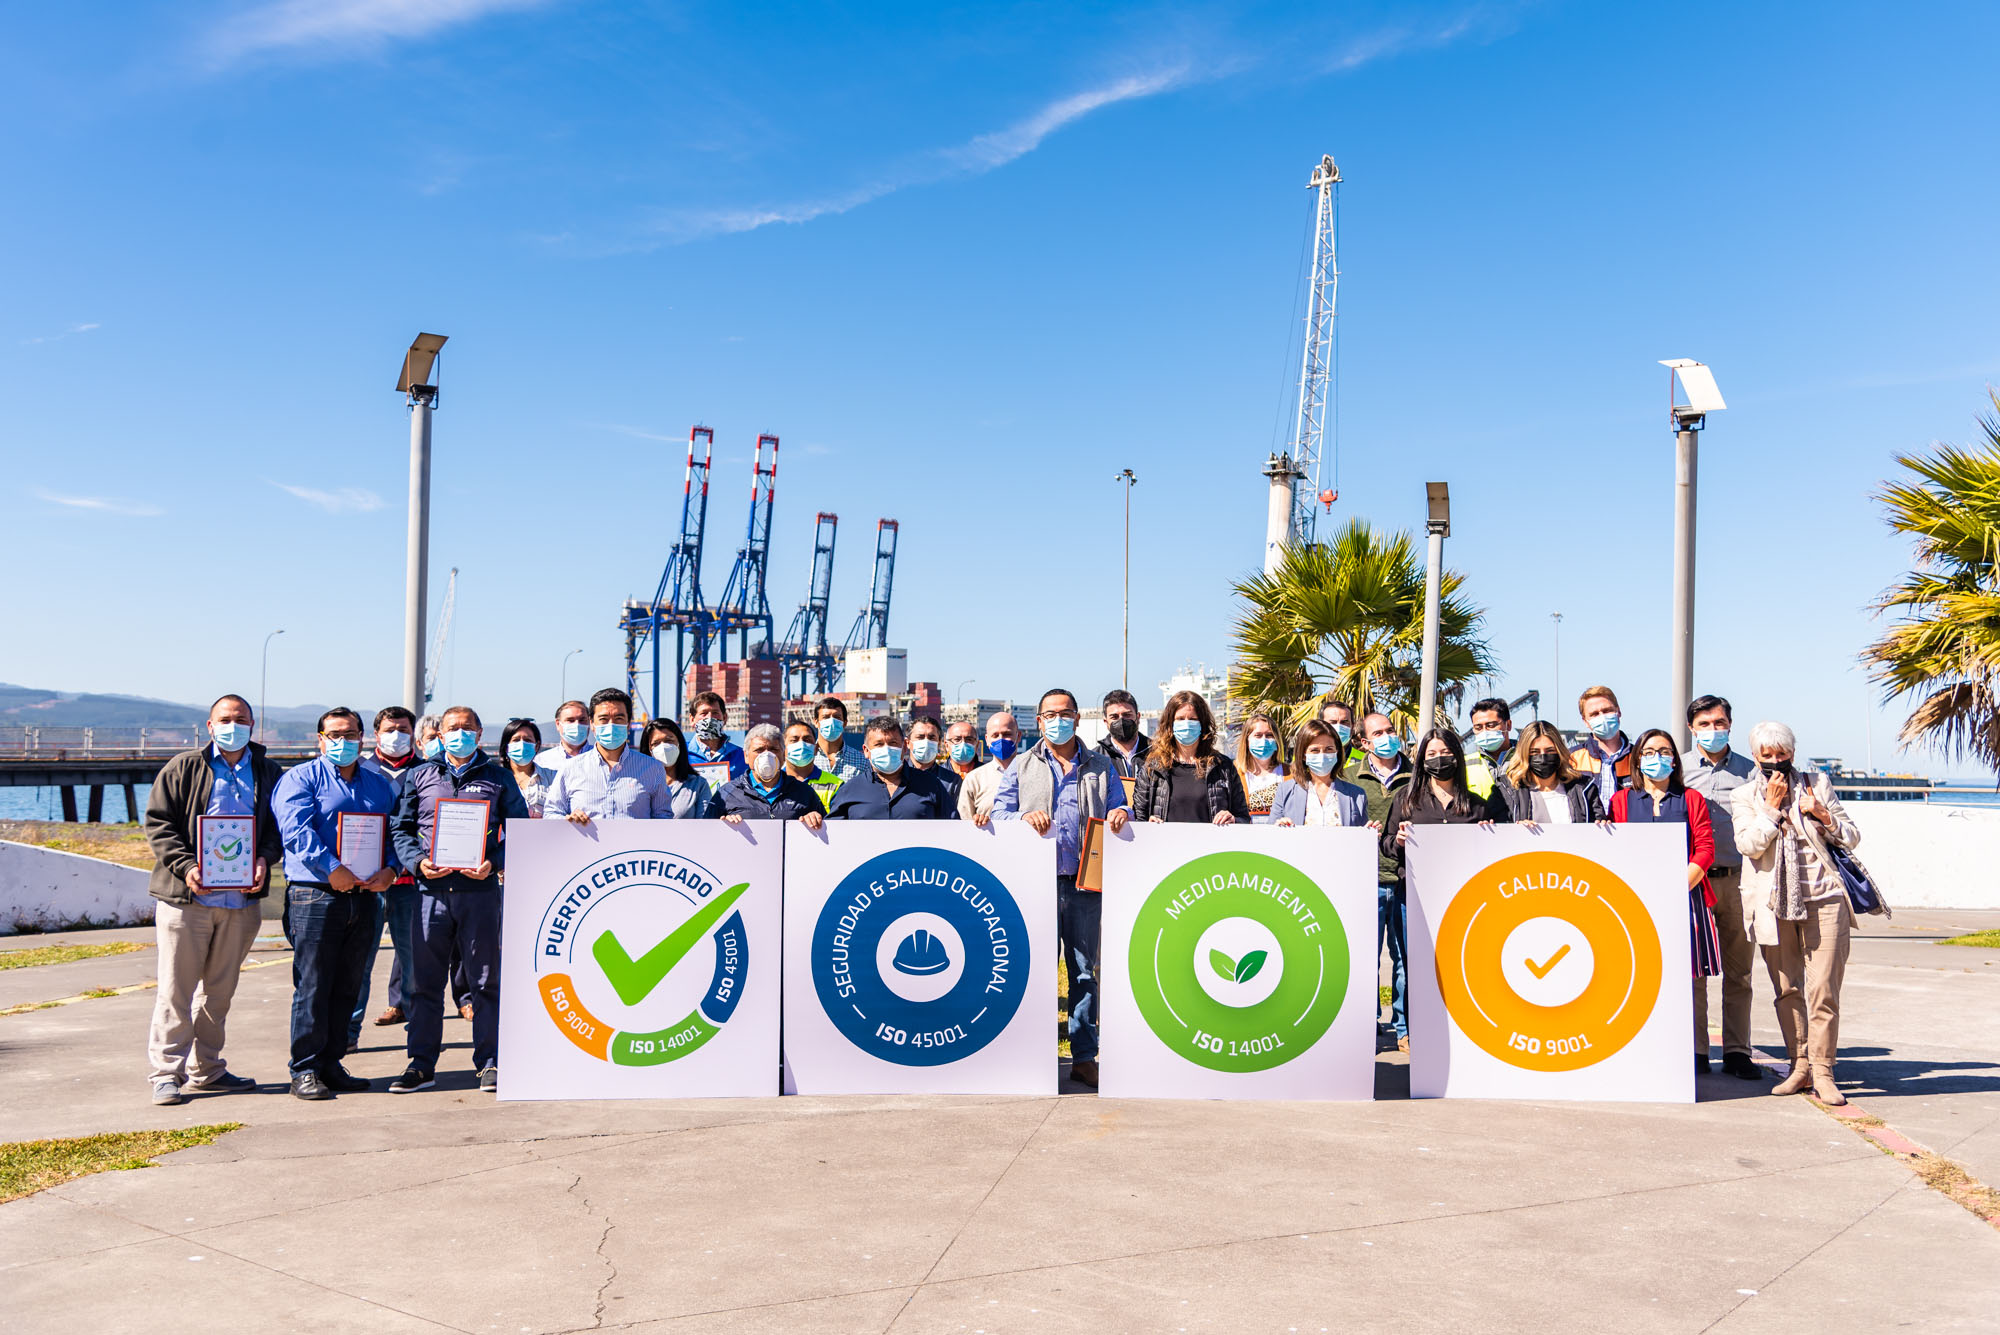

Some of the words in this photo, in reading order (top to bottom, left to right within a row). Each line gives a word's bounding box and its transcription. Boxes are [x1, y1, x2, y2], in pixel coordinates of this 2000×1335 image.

[1498, 872, 1590, 899] CALIDAD
[545, 884, 592, 956] PUERTO
[591, 860, 713, 898] CERTIFICADO
[1165, 872, 1321, 937] MEDIOAMBIENTE
[832, 892, 872, 998] SEGURIDAD
[869, 881, 885, 898] &
[886, 868, 948, 890] SALUD
[951, 877, 1009, 994] OCUPACIONAL
[723, 929, 738, 974] 45001
[715, 977, 734, 1003] ISO
[549, 986, 569, 1012] ISO
[563, 1011, 596, 1040] 9001
[629, 1039, 654, 1054] ISO
[658, 1025, 702, 1052] 14001
[875, 1022, 907, 1045] ISO
[911, 1024, 967, 1048] 45001
[1192, 1030, 1223, 1054] ISO
[1228, 1032, 1285, 1056] 14001
[1507, 1031, 1541, 1054] ISO
[1546, 1033, 1592, 1056] 9001
